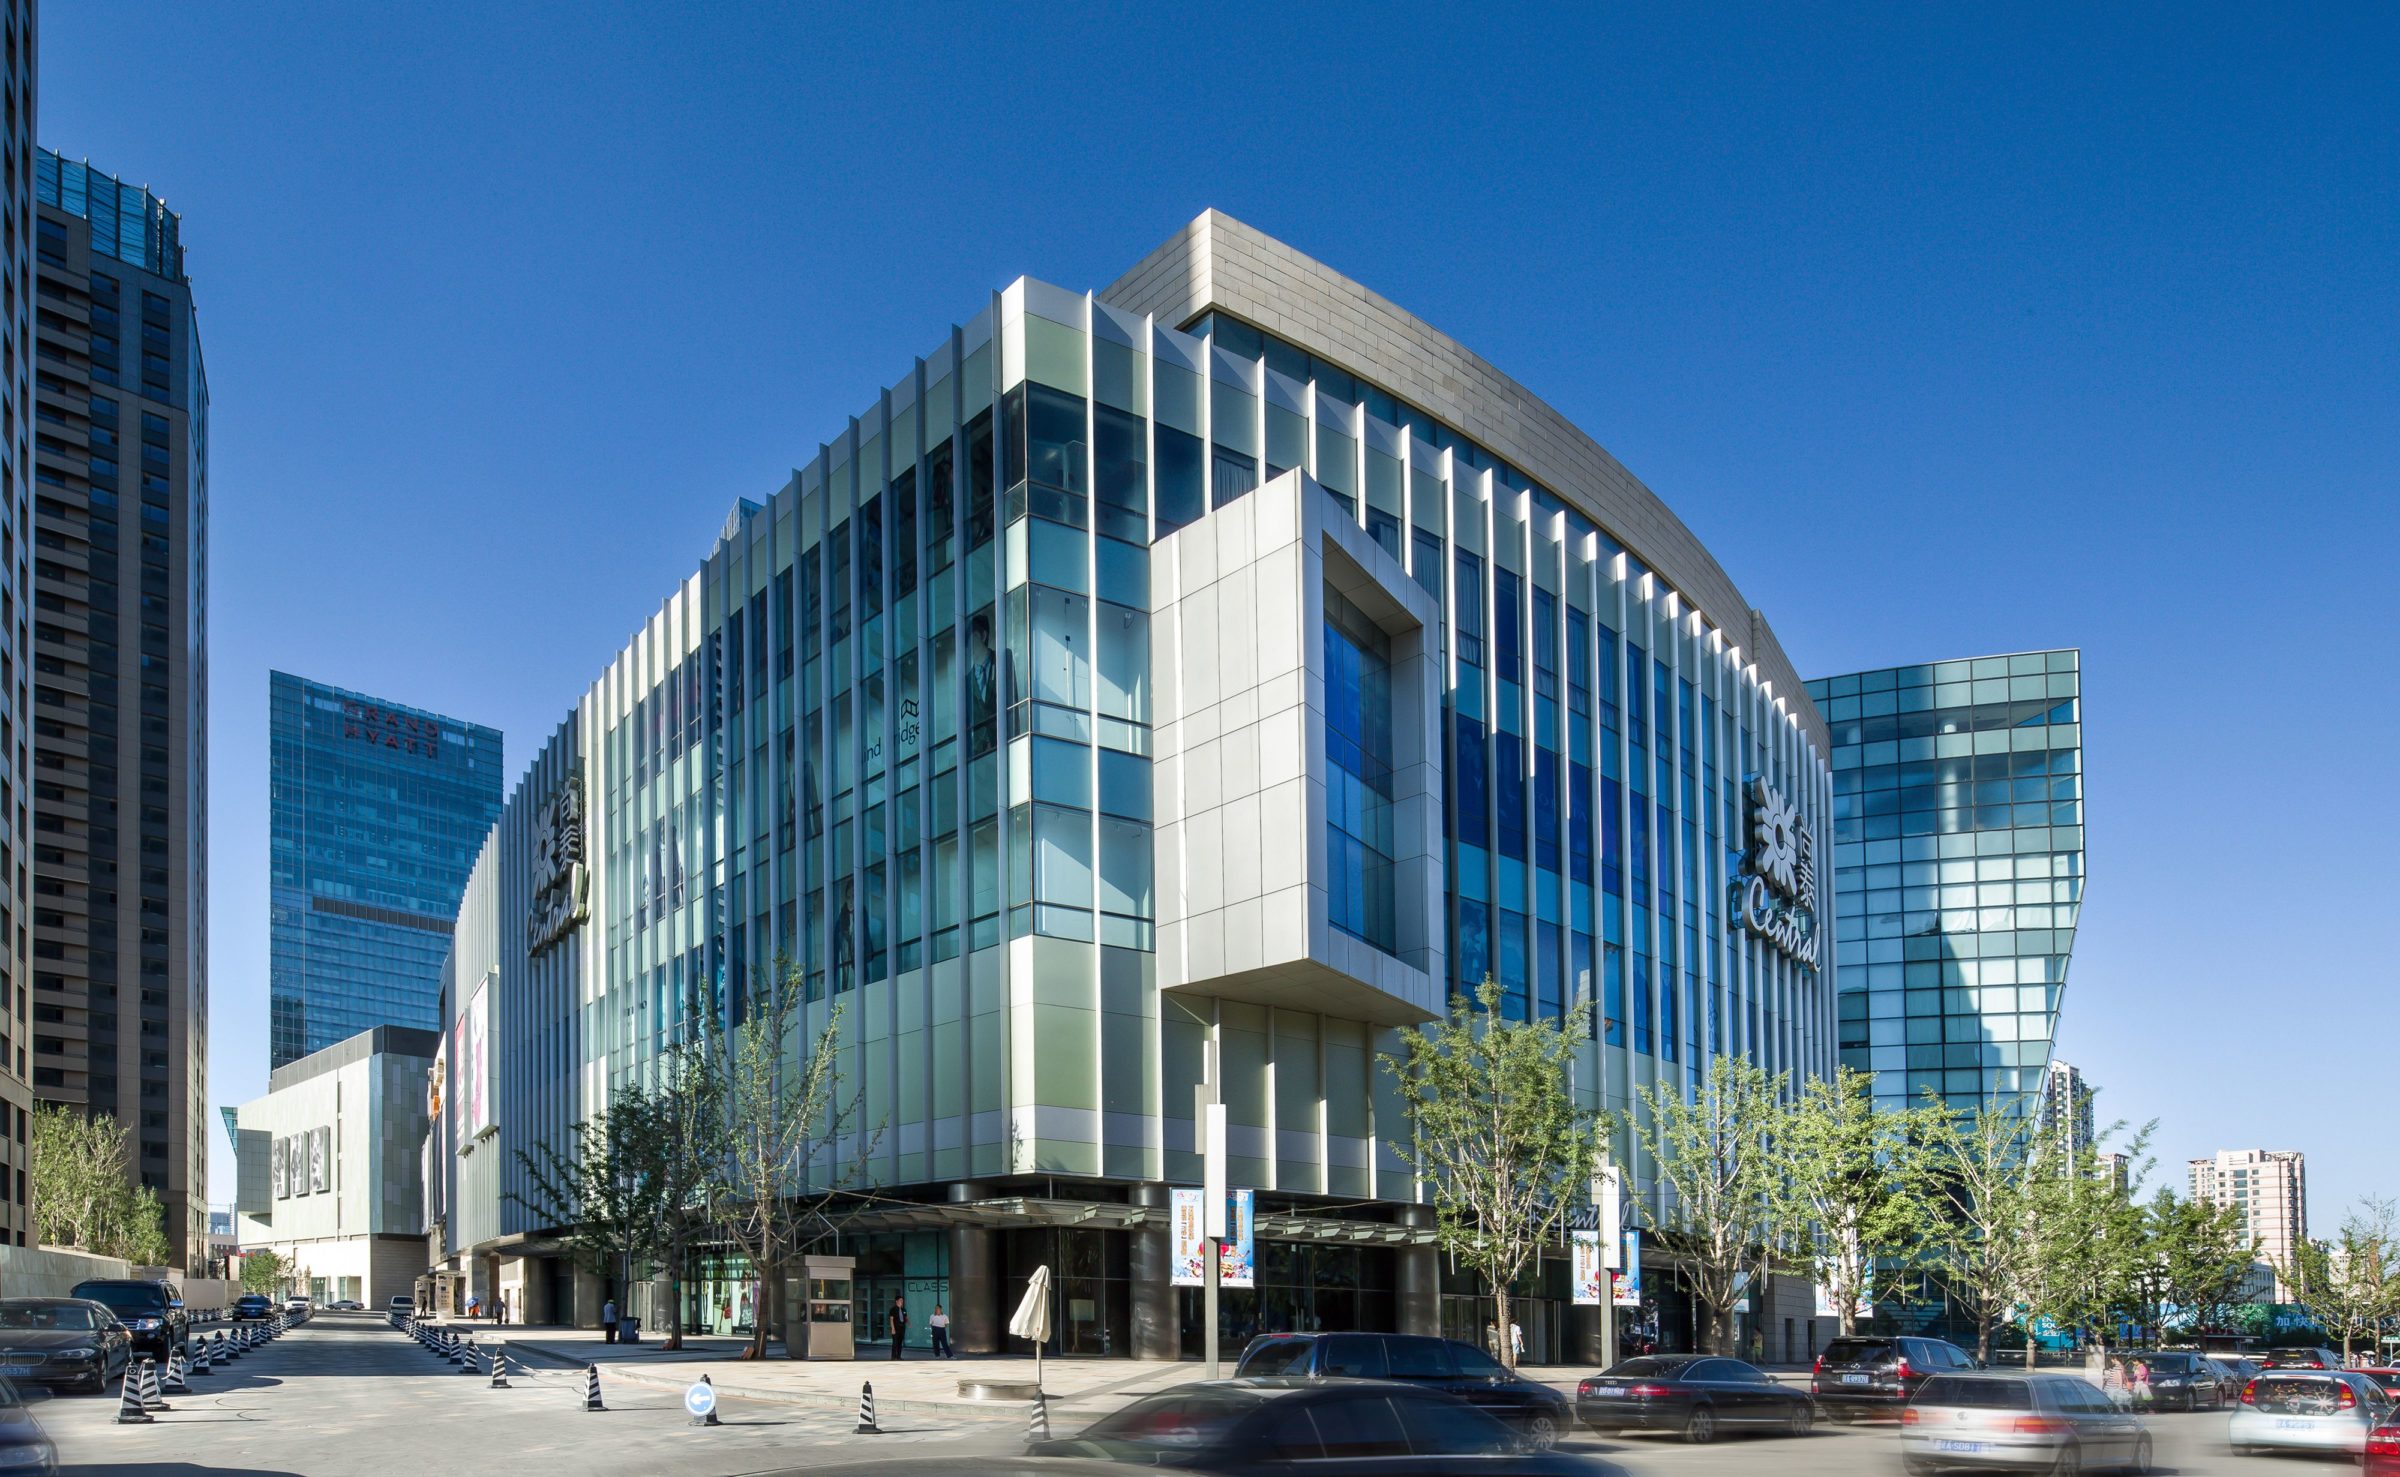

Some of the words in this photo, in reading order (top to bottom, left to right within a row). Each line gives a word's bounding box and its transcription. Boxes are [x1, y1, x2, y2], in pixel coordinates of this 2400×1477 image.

[344, 701, 438, 738] GRAND
[344, 722, 437, 759] HYATT
[526, 862, 585, 956] Central
[1745, 875, 1821, 972] Central
[908, 1281, 949, 1293] CLASS
